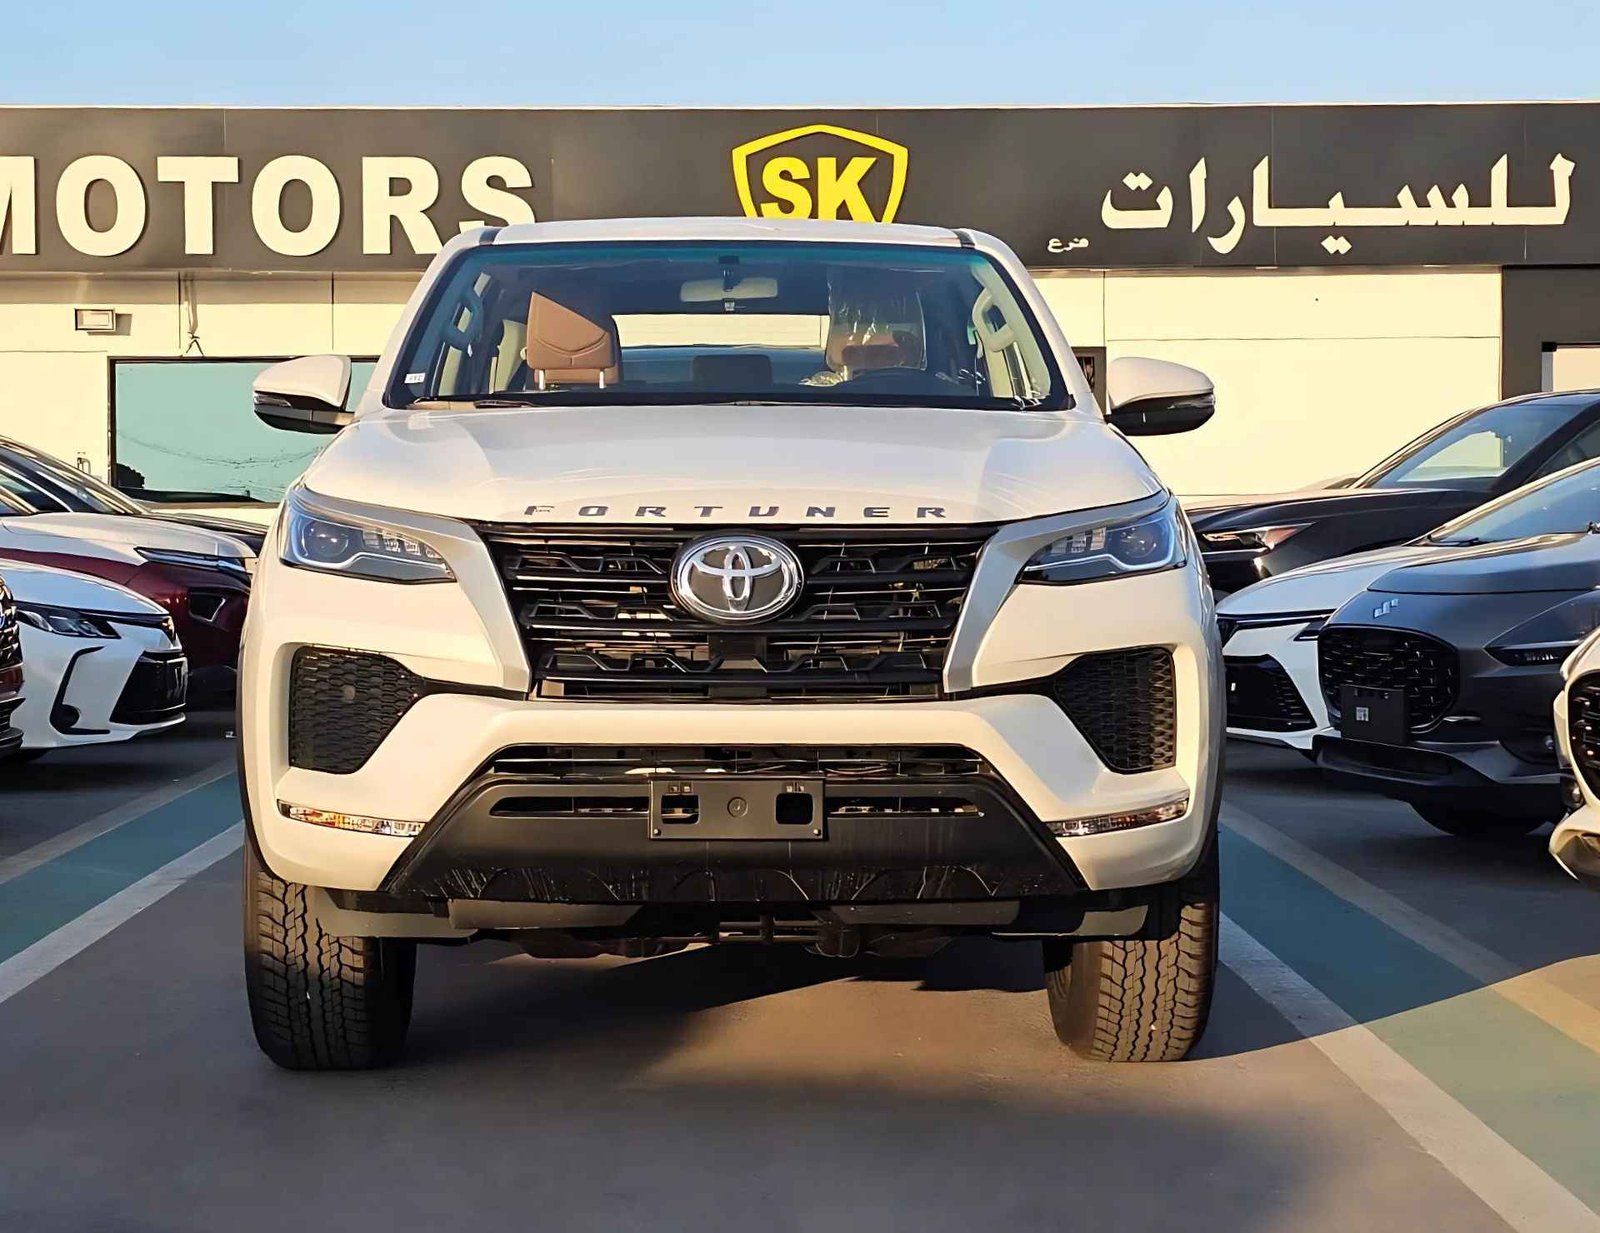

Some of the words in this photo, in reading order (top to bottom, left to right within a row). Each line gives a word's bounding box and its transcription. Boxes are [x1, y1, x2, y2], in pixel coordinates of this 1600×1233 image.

[760, 156, 877, 222] SK
[1101, 153, 1575, 255] للسيارات
[524, 505, 946, 518] FORTUNER
